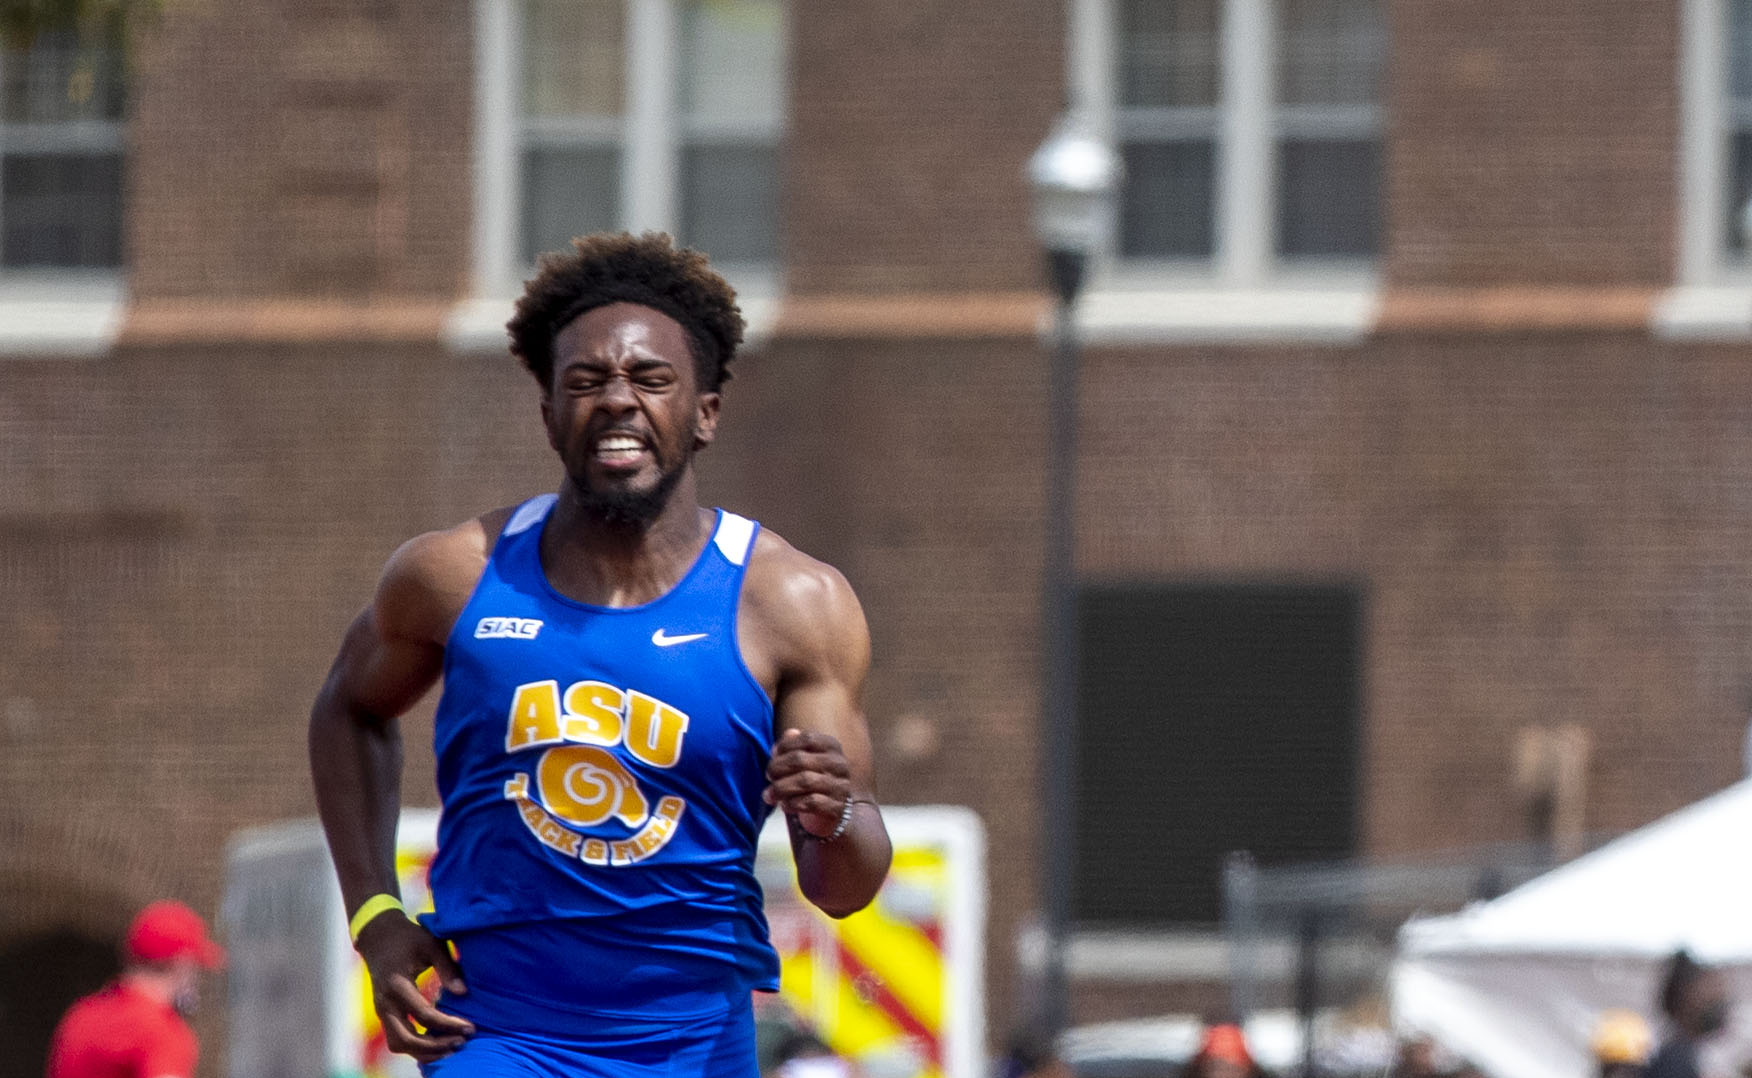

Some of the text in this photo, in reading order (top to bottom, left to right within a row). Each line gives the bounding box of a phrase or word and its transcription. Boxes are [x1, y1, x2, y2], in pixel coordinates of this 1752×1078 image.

[477, 619, 539, 637] SIAC
[506, 680, 689, 768] ASU
[504, 773, 686, 866] TACK & FIELD
